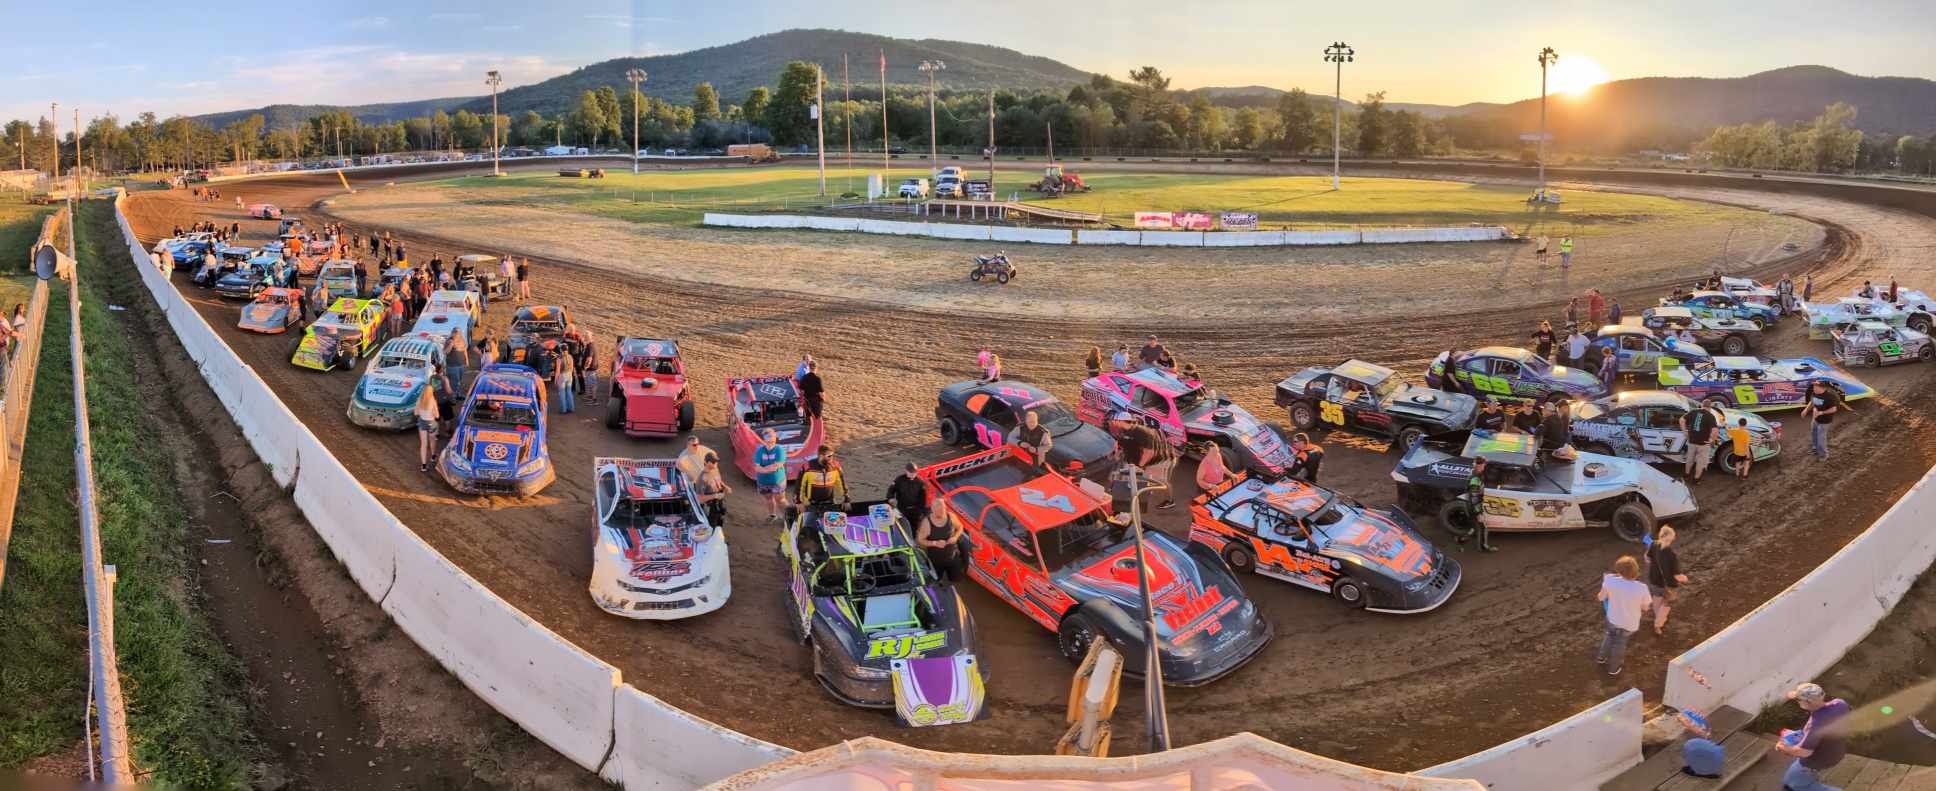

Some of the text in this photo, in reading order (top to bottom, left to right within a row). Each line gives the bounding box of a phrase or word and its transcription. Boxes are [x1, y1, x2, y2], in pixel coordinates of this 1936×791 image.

[1733, 385, 1760, 405] 6
[1319, 400, 1345, 426] 35
[1439, 463, 1473, 475] ALLSTA
